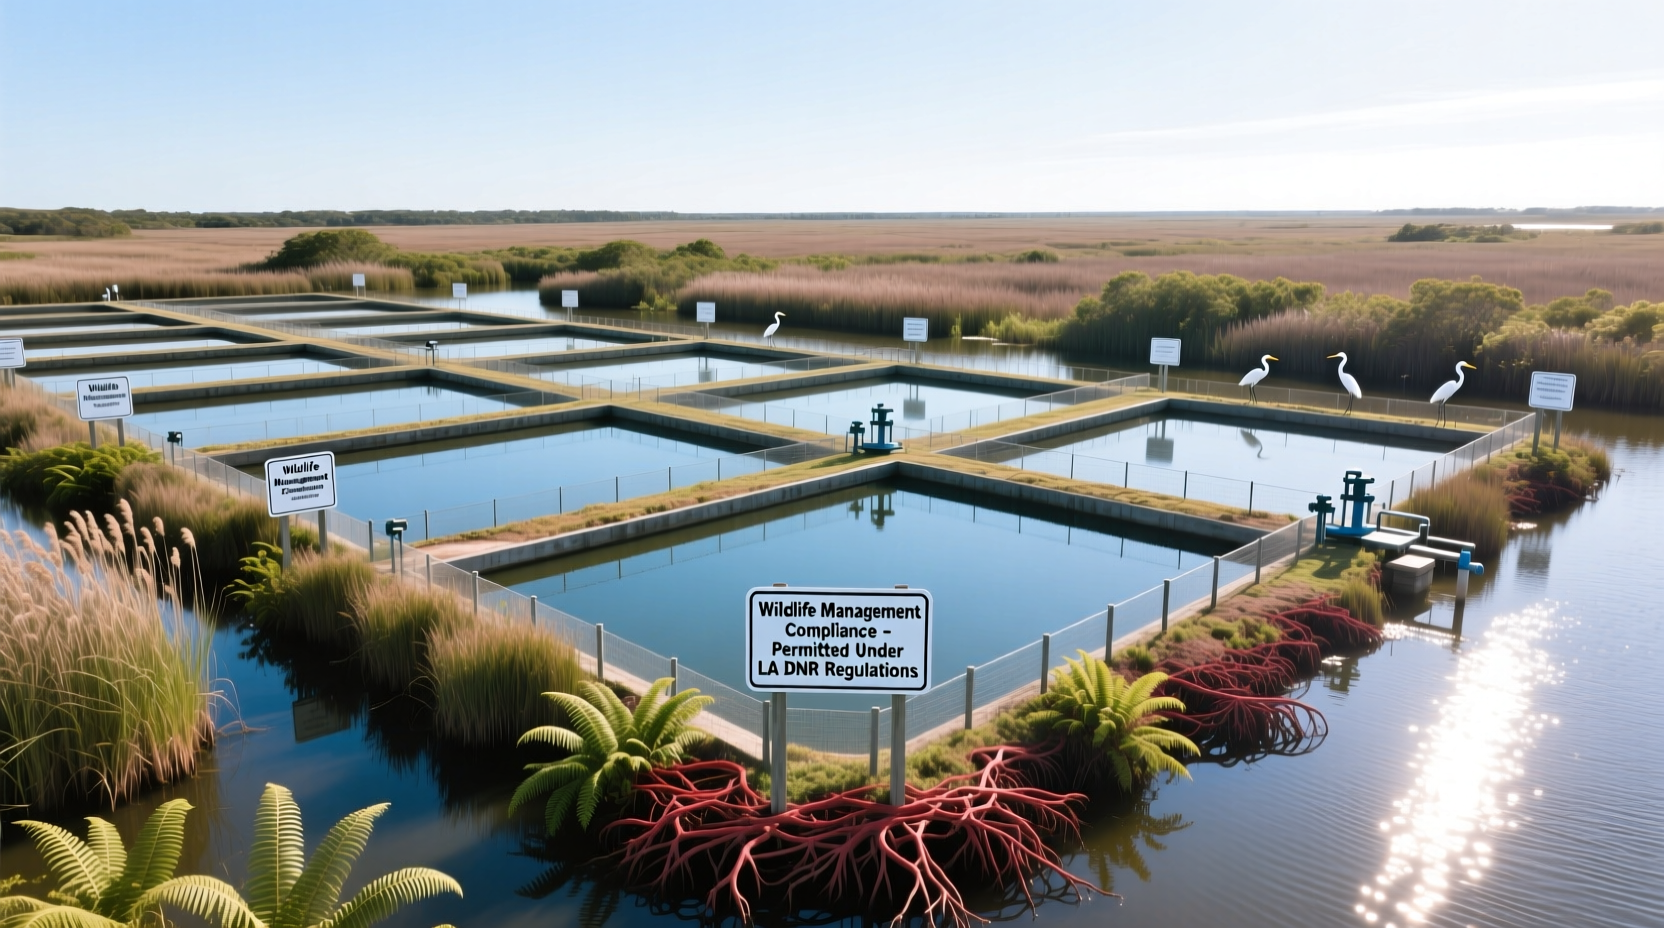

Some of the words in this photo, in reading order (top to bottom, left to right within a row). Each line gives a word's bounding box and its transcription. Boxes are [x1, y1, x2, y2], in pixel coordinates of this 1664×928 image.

[758, 601, 817, 618] Wildlife
[821, 602, 921, 621] Management
[785, 622, 877, 640] Compliance
[772, 641, 849, 658] Permitted
[855, 642, 904, 658] Under
[758, 660, 779, 676] LA
[783, 660, 819, 676] DNR
[824, 661, 919, 681] Regulations
